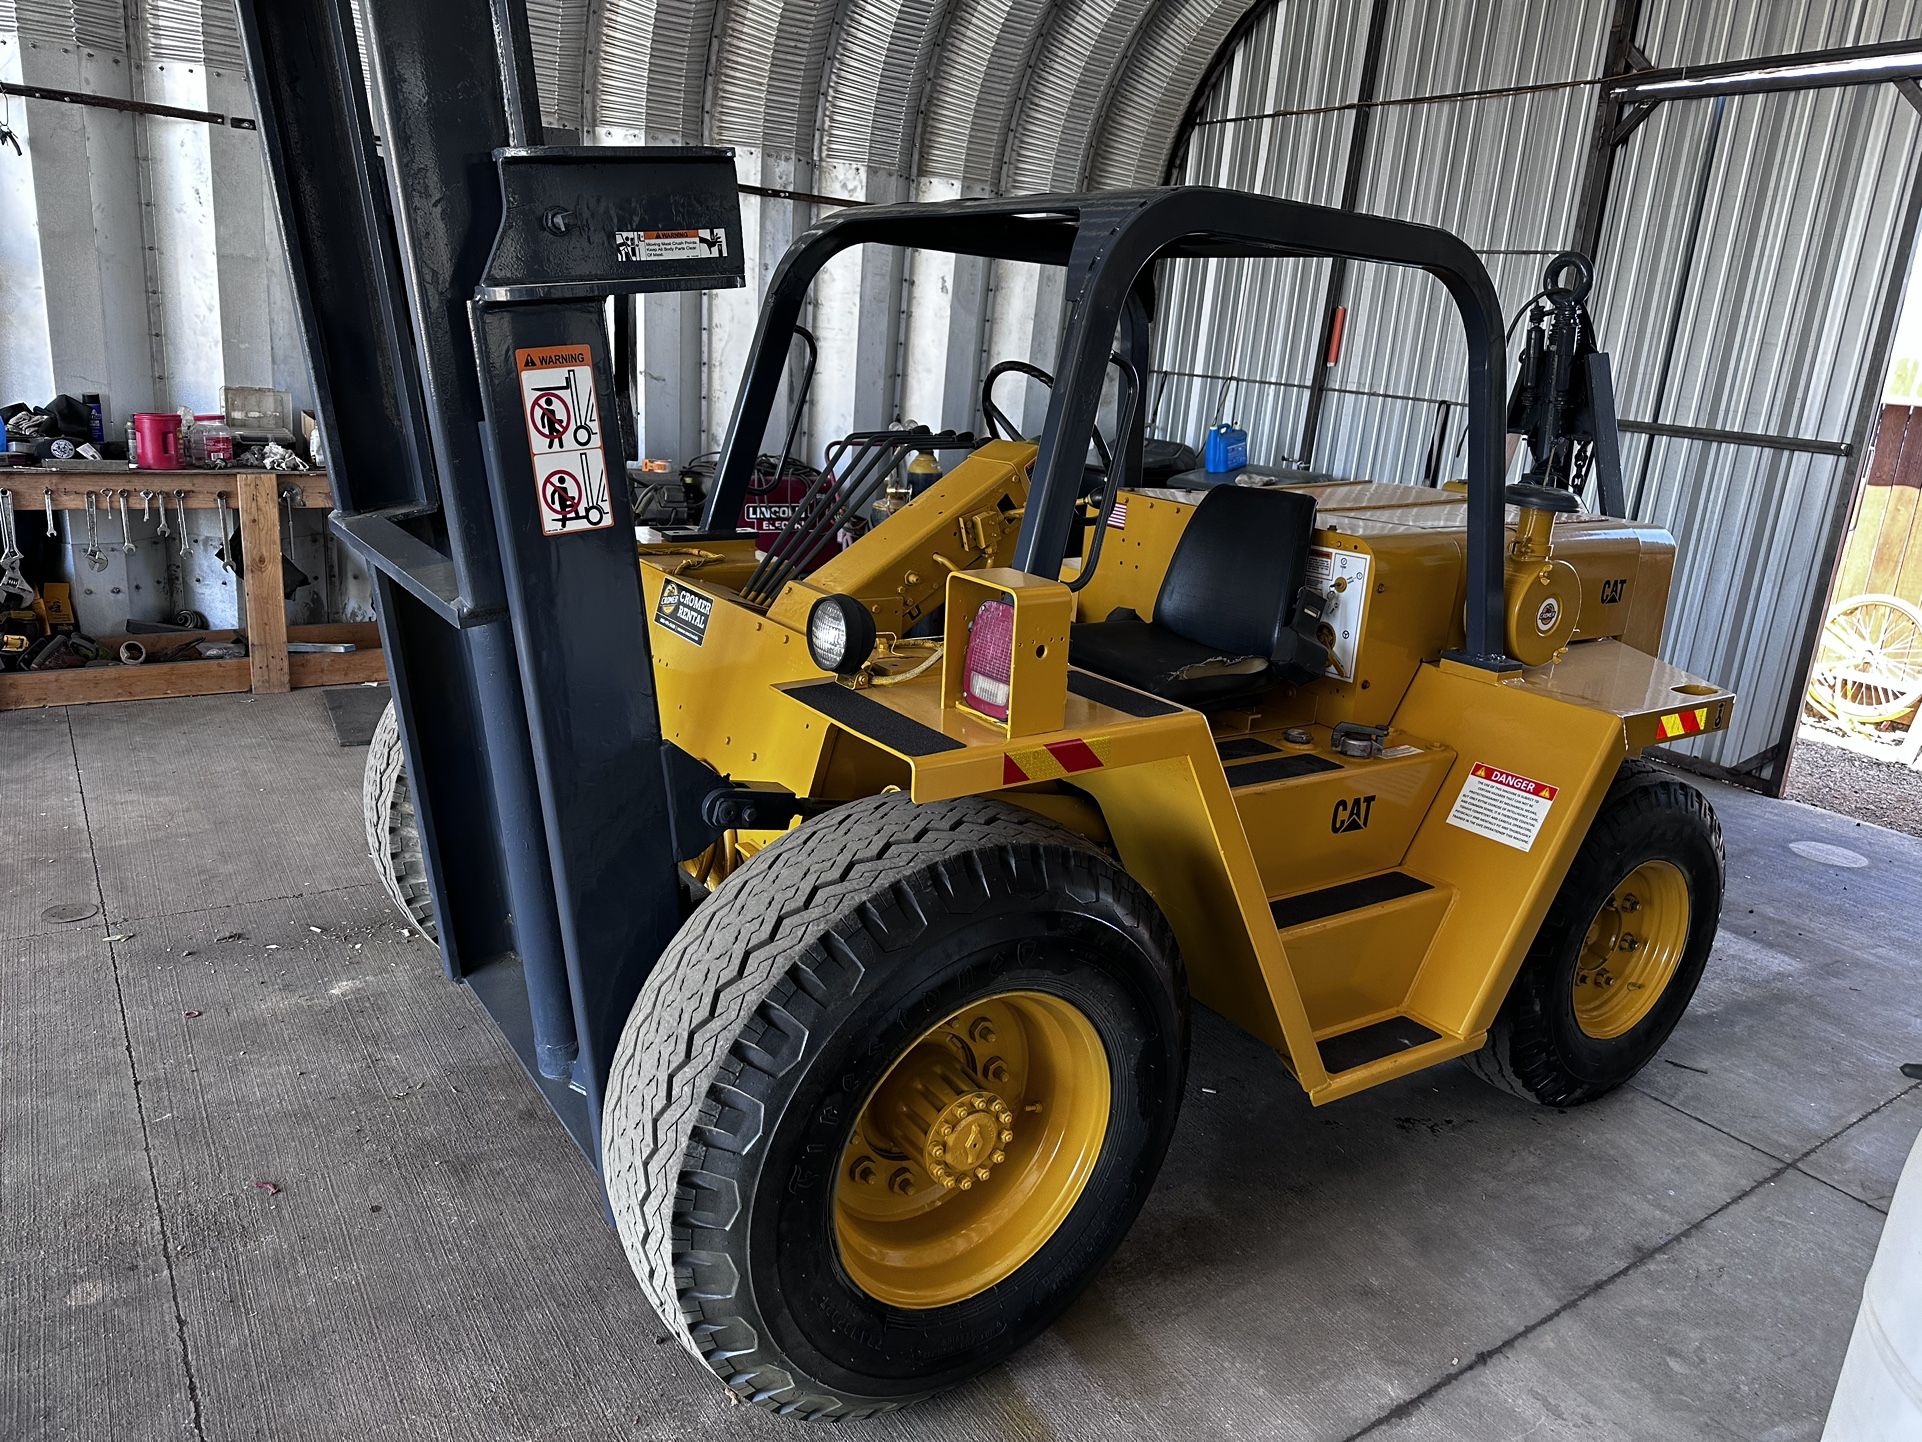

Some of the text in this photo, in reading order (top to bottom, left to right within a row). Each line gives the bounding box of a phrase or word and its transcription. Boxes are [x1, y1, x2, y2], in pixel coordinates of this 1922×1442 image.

[538, 353, 585, 366] WARNING
[749, 507, 805, 518] LINCOL
[679, 590, 712, 615] CROMER
[1601, 579, 1627, 604] CAT
[677, 605, 705, 629] RENTAL
[1490, 770, 1536, 792] DANGER
[1332, 795, 1376, 834] CAT
